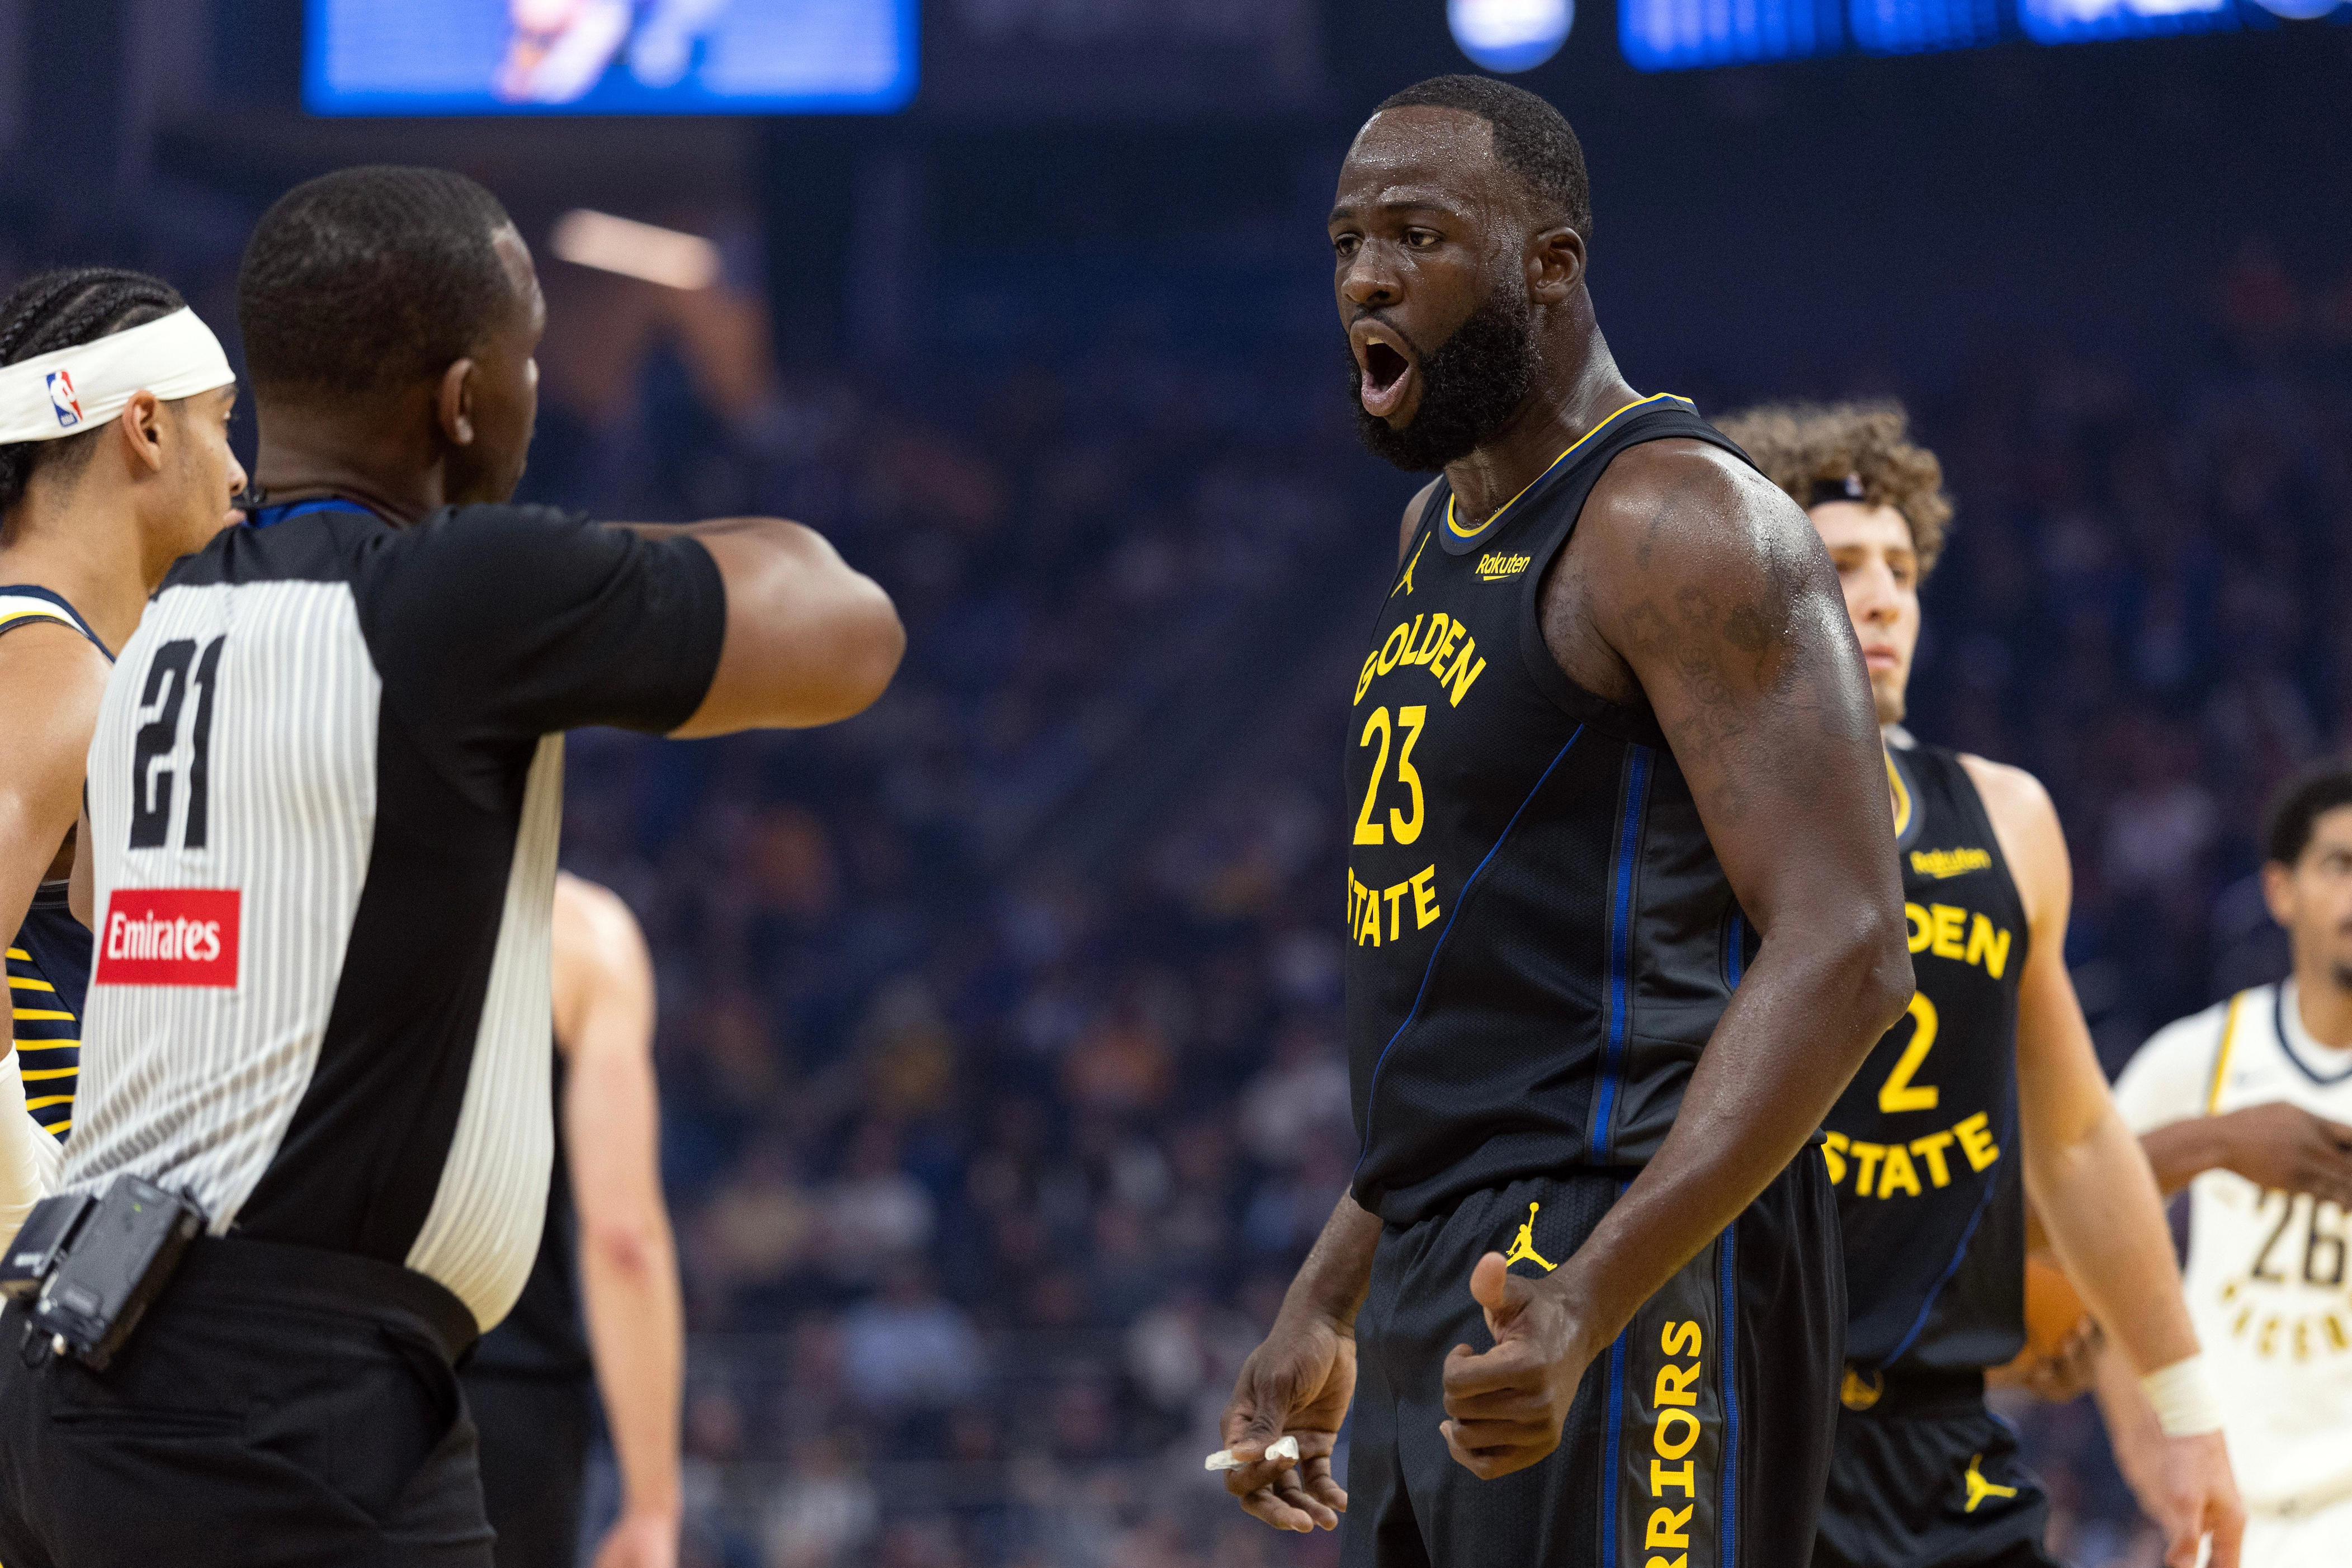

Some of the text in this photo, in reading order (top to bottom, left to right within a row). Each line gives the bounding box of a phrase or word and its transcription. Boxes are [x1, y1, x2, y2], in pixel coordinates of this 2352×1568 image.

[1475, 552, 1531, 574] Rakuten
[1353, 613, 1486, 708] GOLDEN
[129, 634, 227, 851] 21
[1353, 705, 1427, 844] 23
[107, 910, 220, 961] Emirates
[1878, 990, 1939, 1113] 2
[1821, 1111, 2000, 1201] STATE
